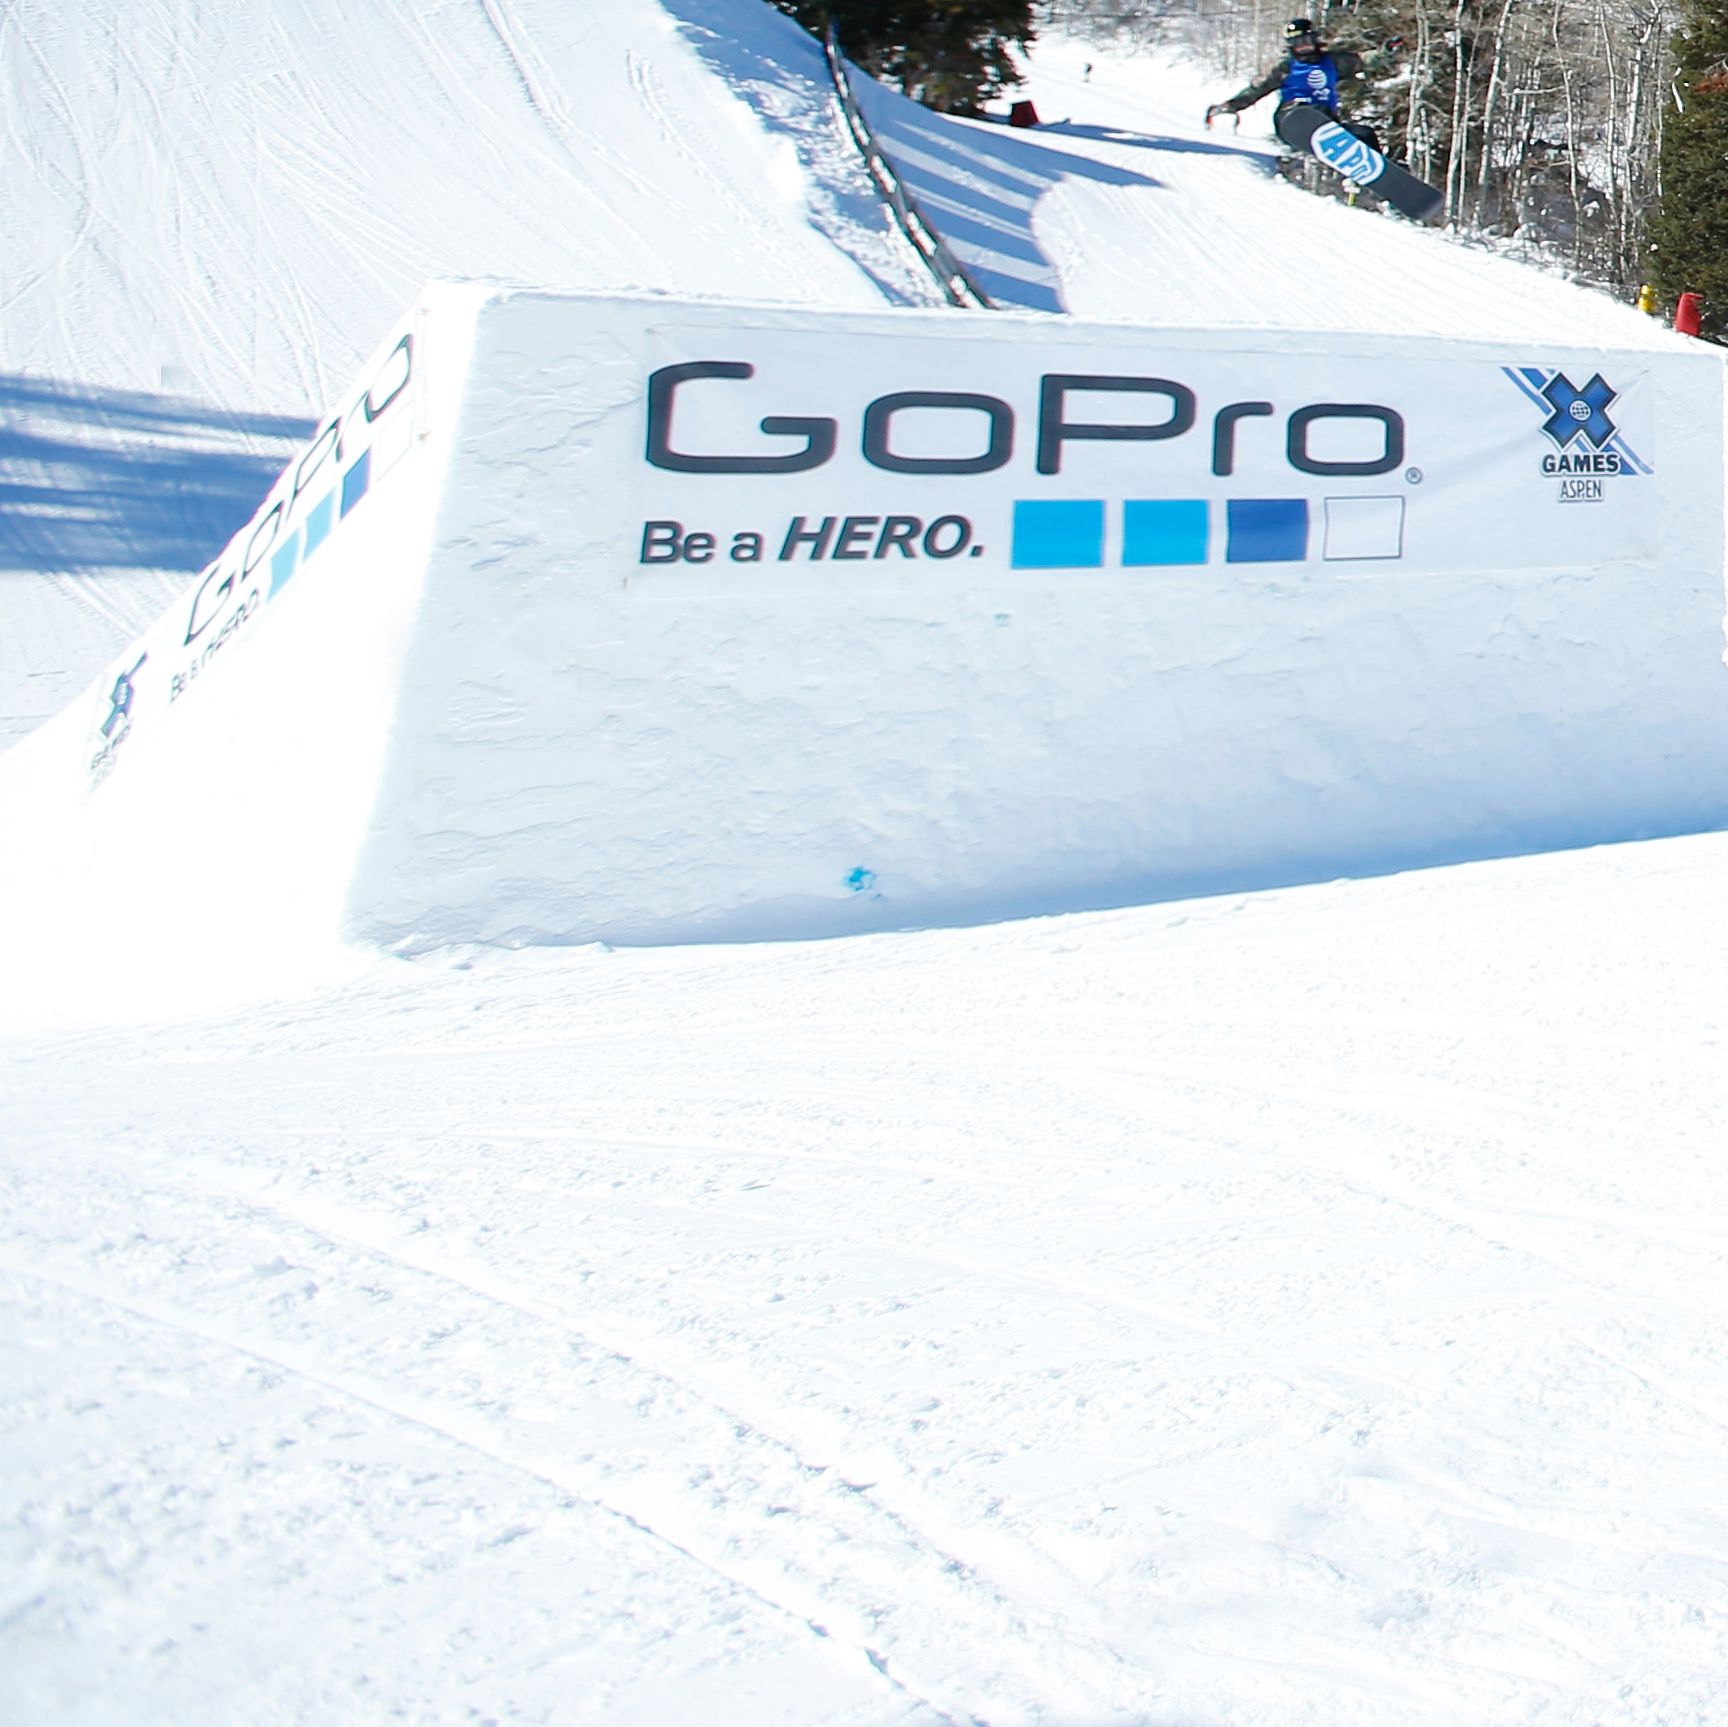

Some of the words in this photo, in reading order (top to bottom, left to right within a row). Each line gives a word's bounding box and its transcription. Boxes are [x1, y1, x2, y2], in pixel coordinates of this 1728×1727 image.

[646, 361, 1404, 476] GoPro
[1543, 454, 1619, 474] GAMES
[1560, 480, 1602, 499] ASPEN
[640, 520, 717, 564] Be
[730, 531, 764, 562] a
[778, 514, 985, 562] HERO.
